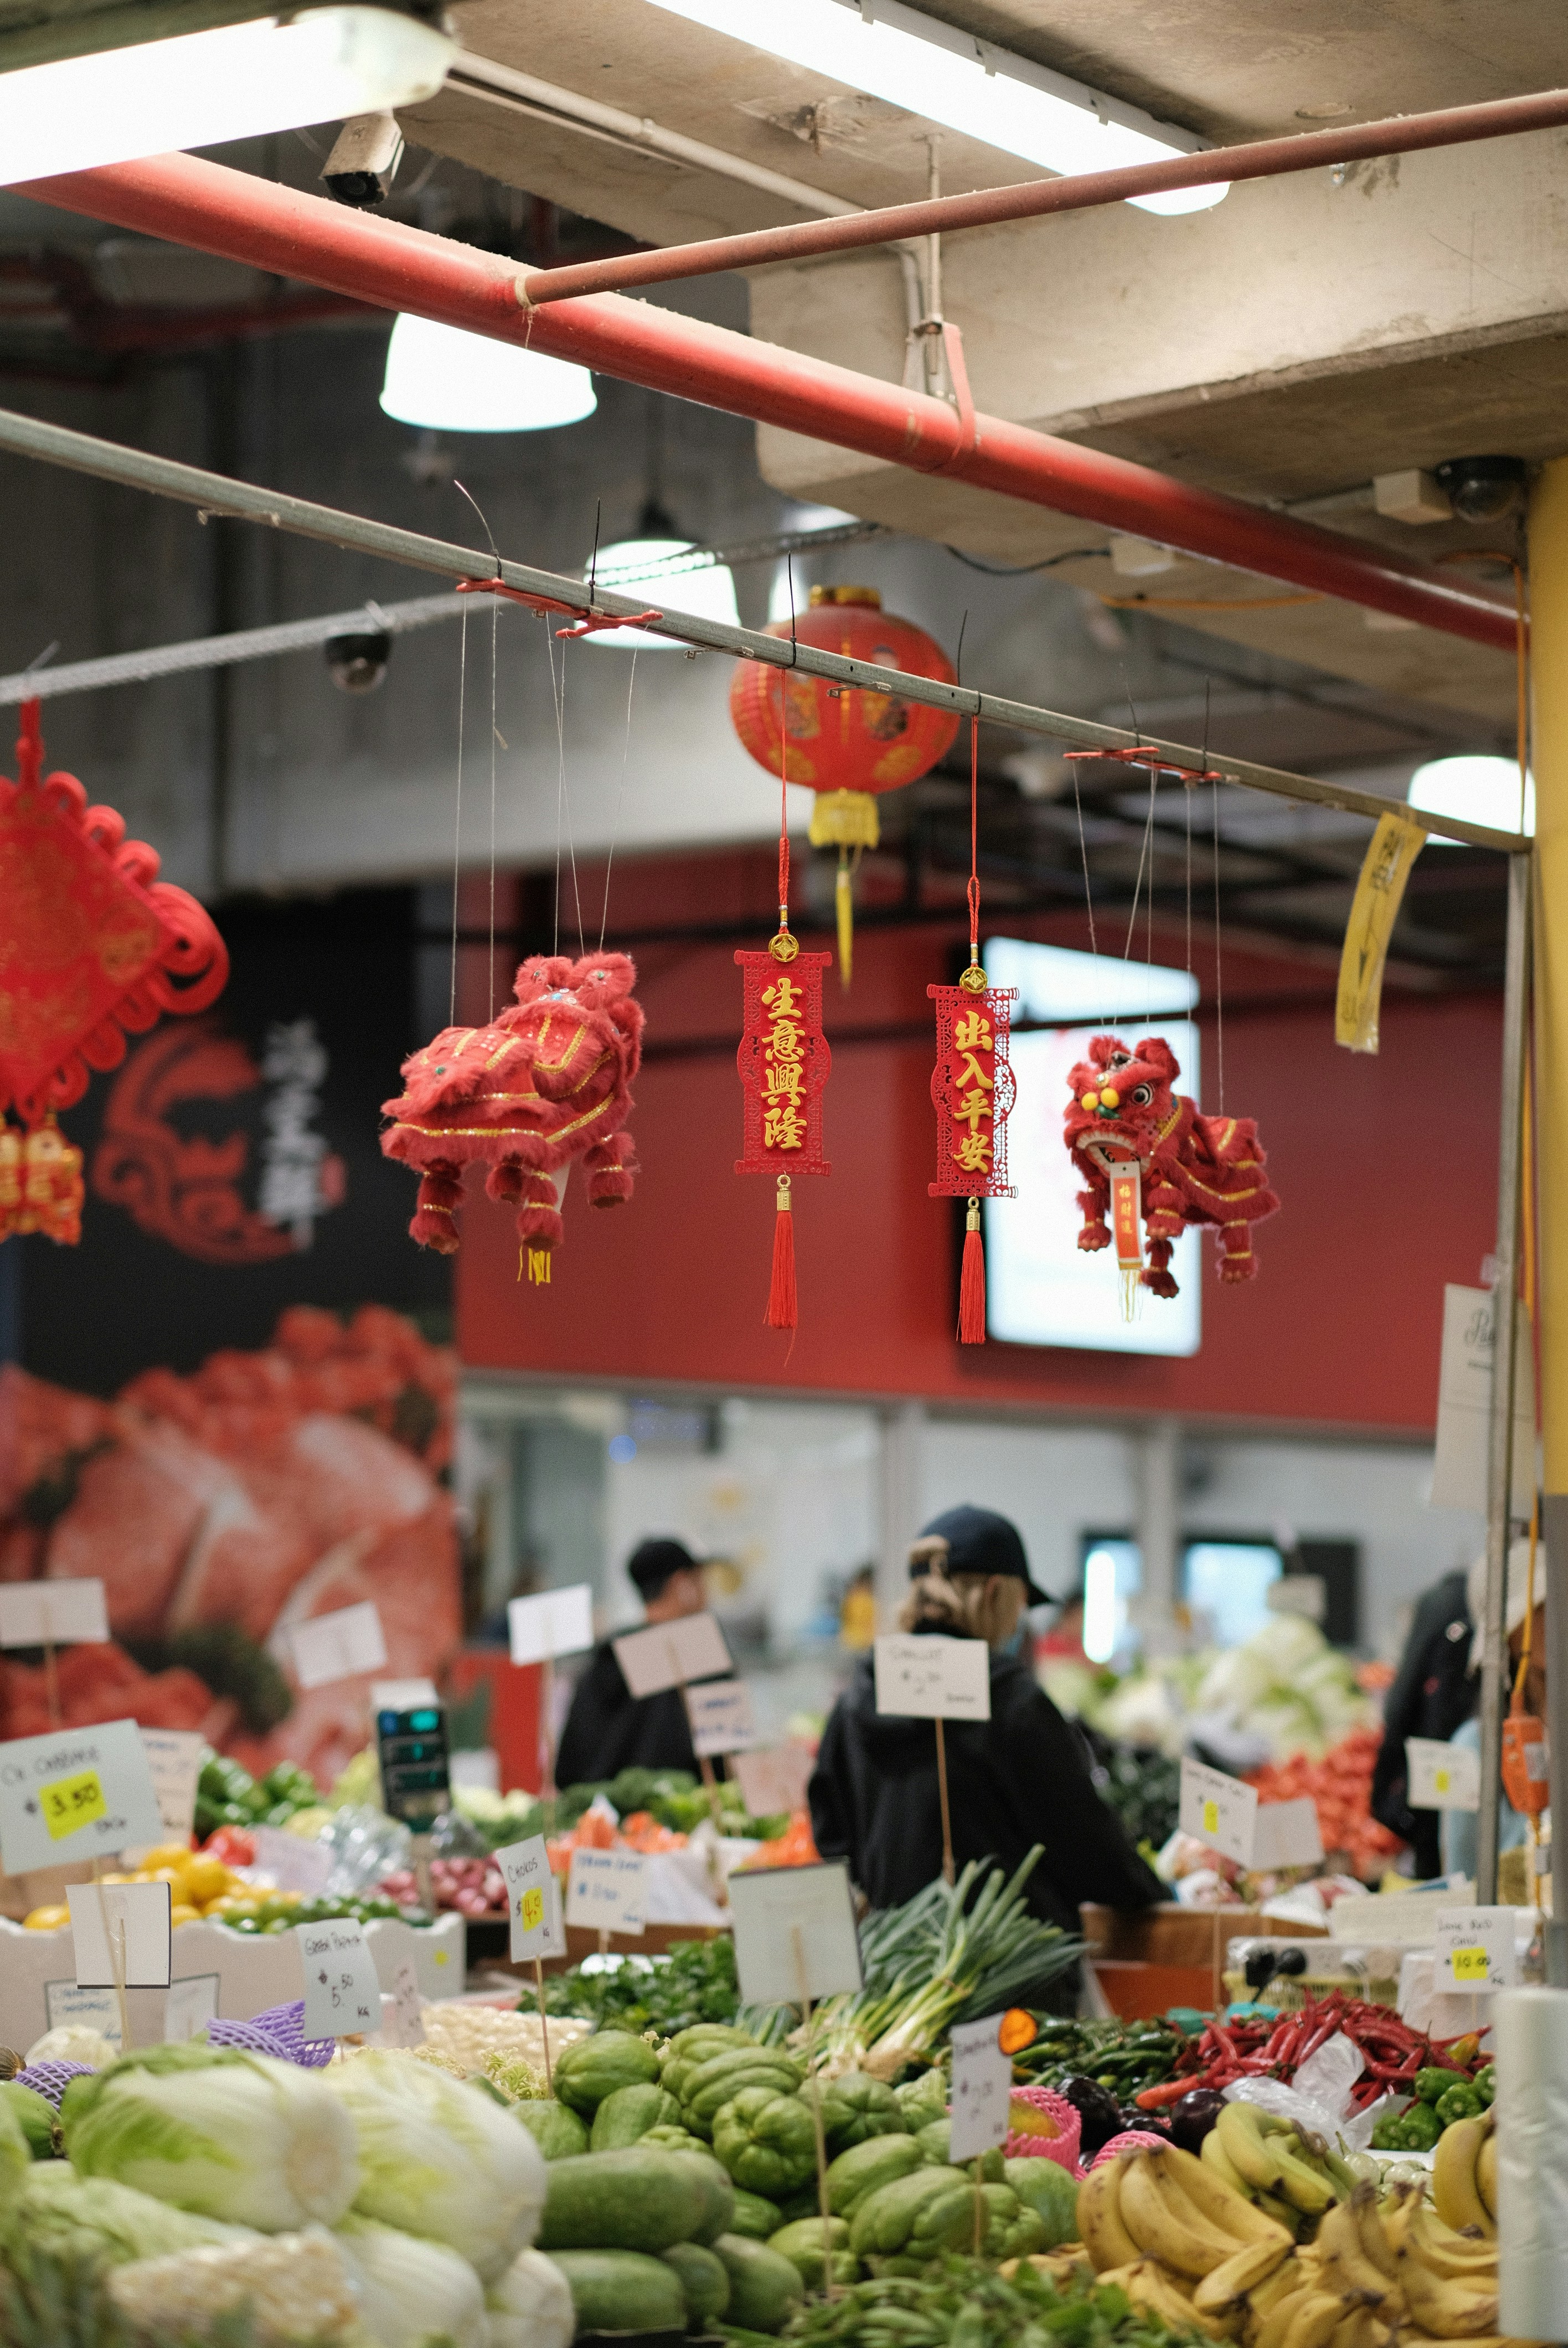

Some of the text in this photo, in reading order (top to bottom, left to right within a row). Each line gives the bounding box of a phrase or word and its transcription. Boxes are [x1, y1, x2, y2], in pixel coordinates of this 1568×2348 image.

[761, 977, 807, 1150] 生意興隆
[953, 1010, 994, 1175] 出入平安
